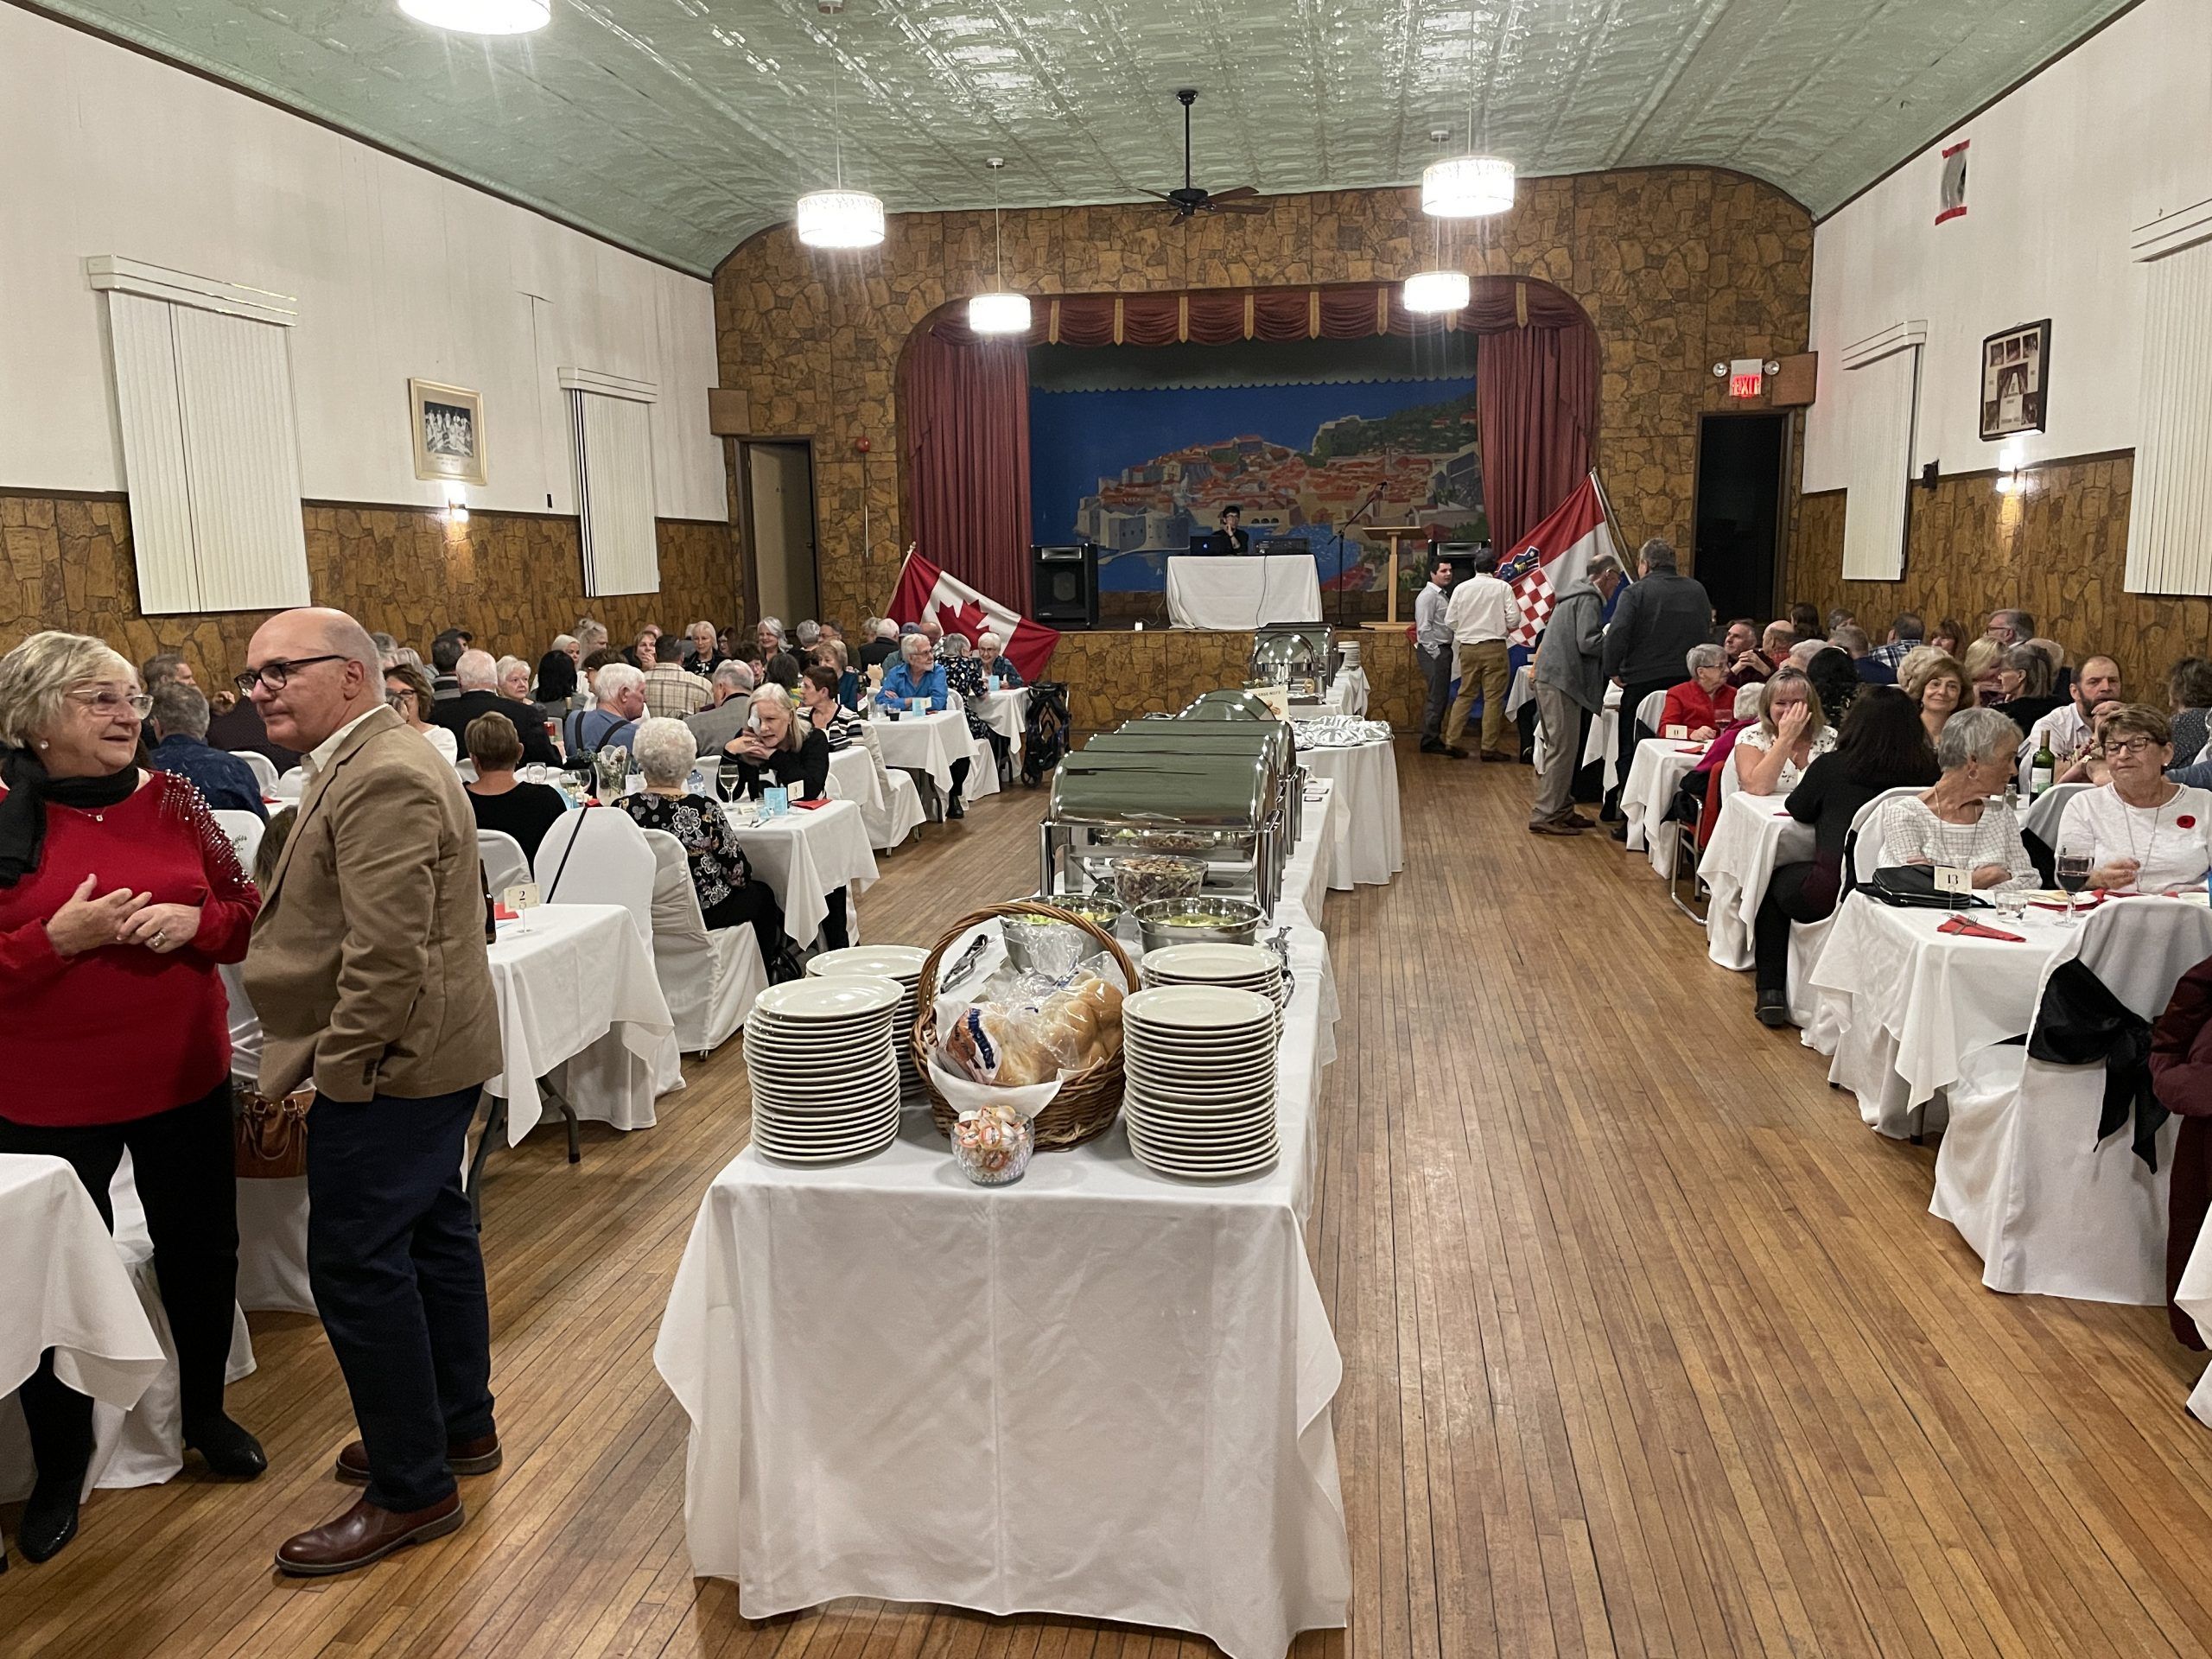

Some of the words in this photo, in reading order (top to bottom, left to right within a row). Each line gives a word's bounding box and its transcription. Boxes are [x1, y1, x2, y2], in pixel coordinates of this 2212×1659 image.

[1733, 377, 1760, 395] EXIT
[1948, 874, 1959, 884] 13
[519, 891, 525, 900] 2
